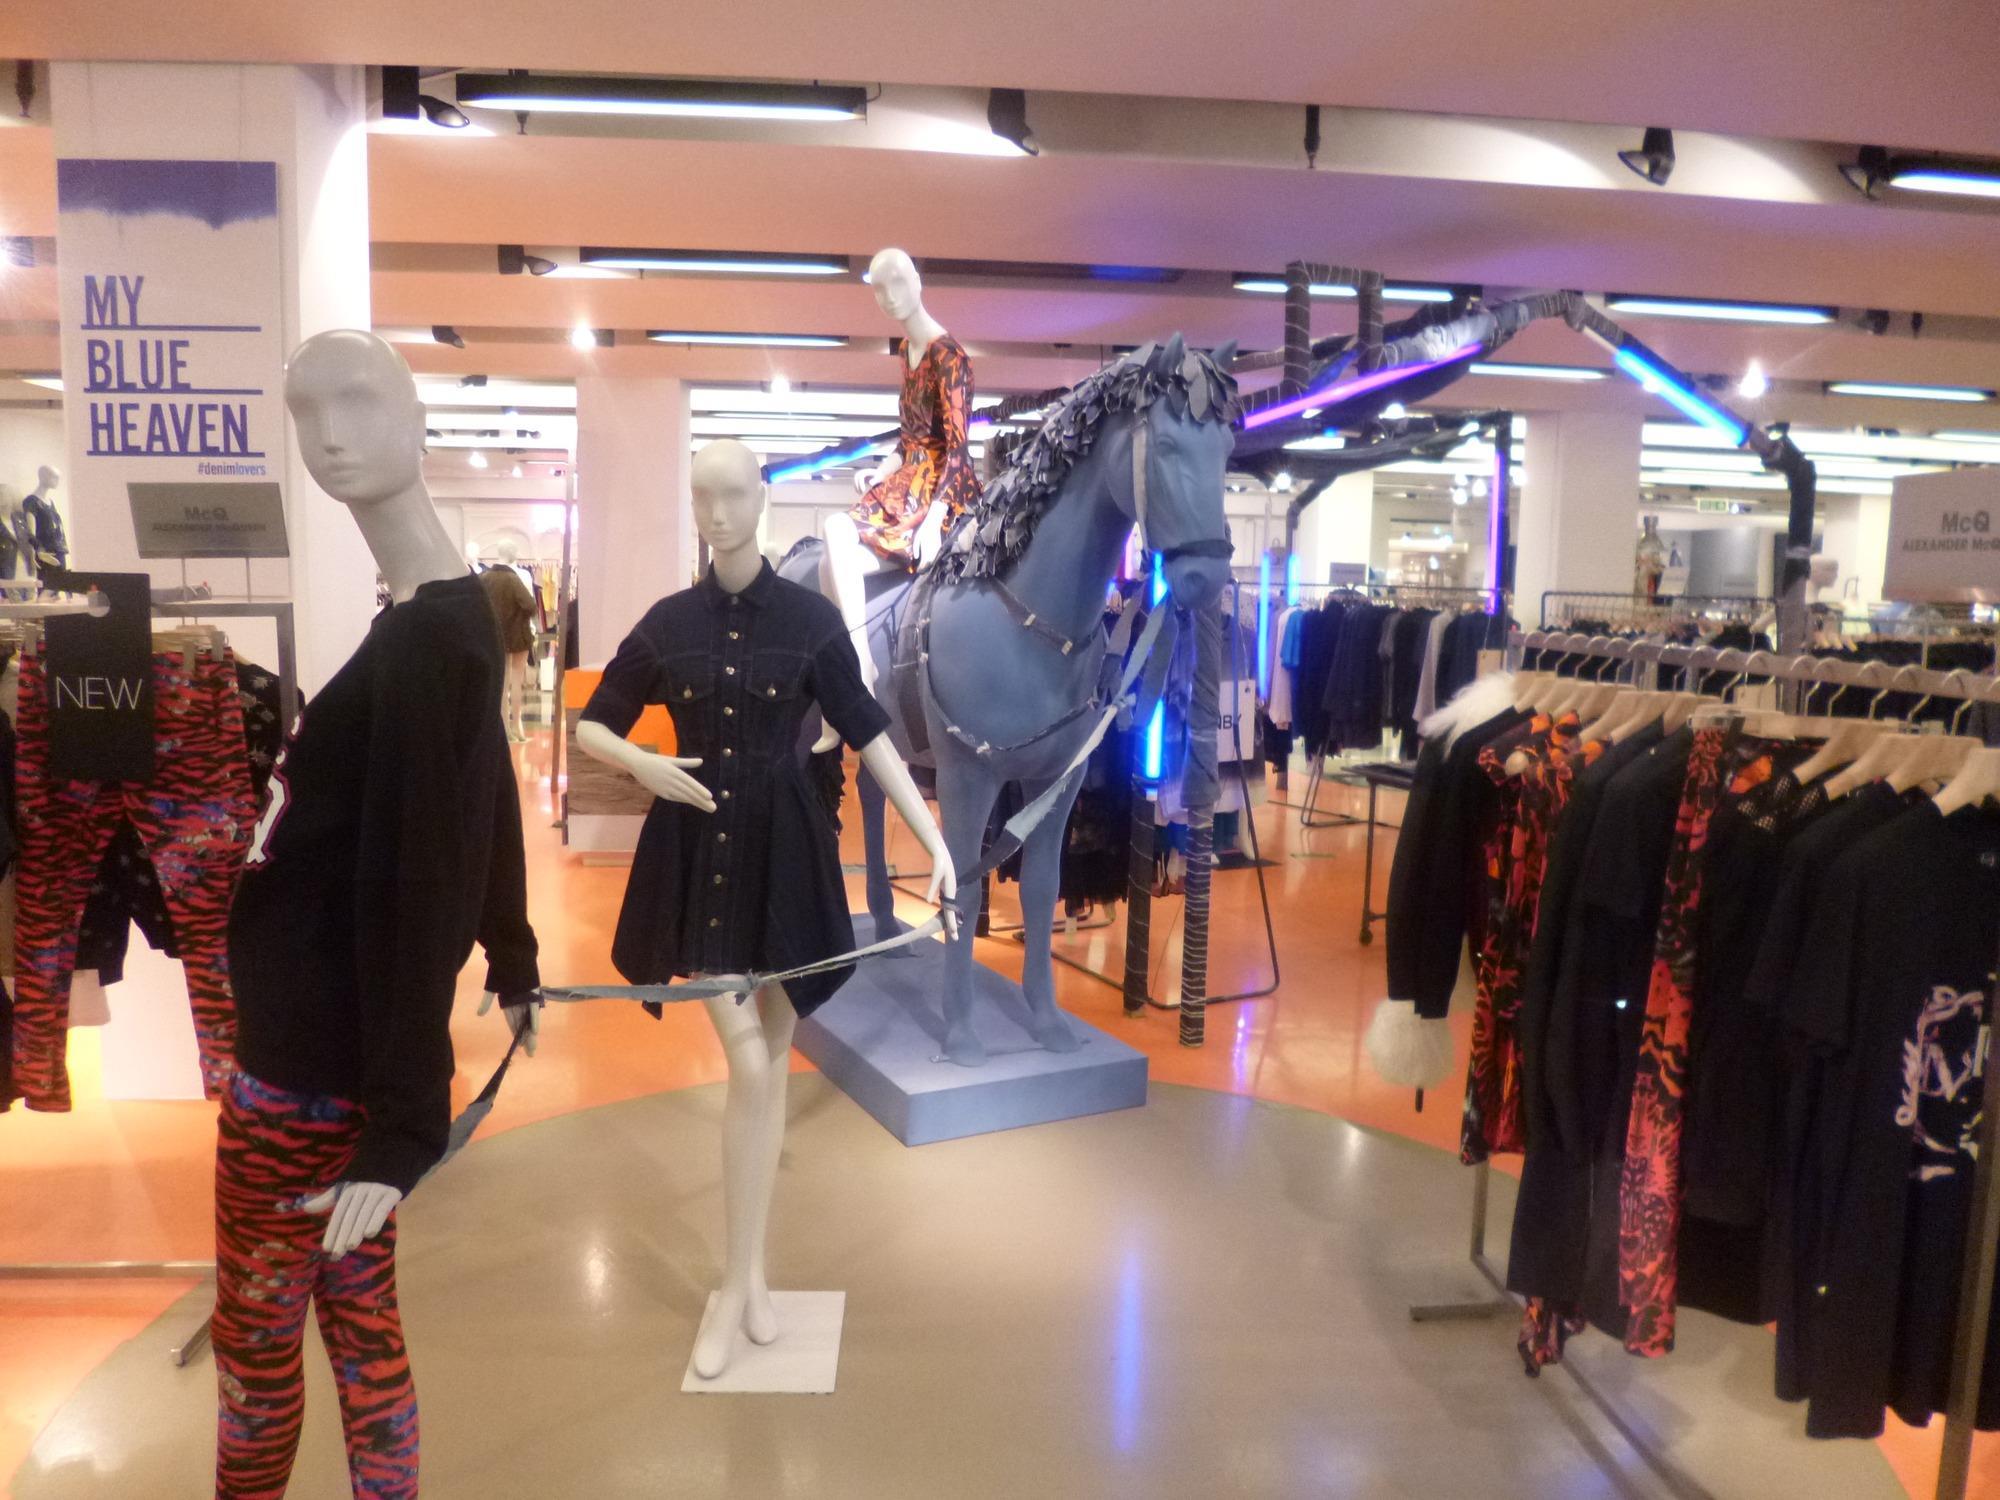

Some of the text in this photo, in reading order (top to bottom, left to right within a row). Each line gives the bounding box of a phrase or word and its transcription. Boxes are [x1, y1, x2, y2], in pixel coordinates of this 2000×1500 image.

[84, 275, 144, 328] MY
[87, 339, 192, 391] BLUE
[90, 402, 248, 453] HEAVEN
[198, 462, 266, 475] #denimlovers
[184, 506, 229, 520] McQ
[1941, 510, 1990, 533] McQ
[55, 676, 142, 710] NEW
